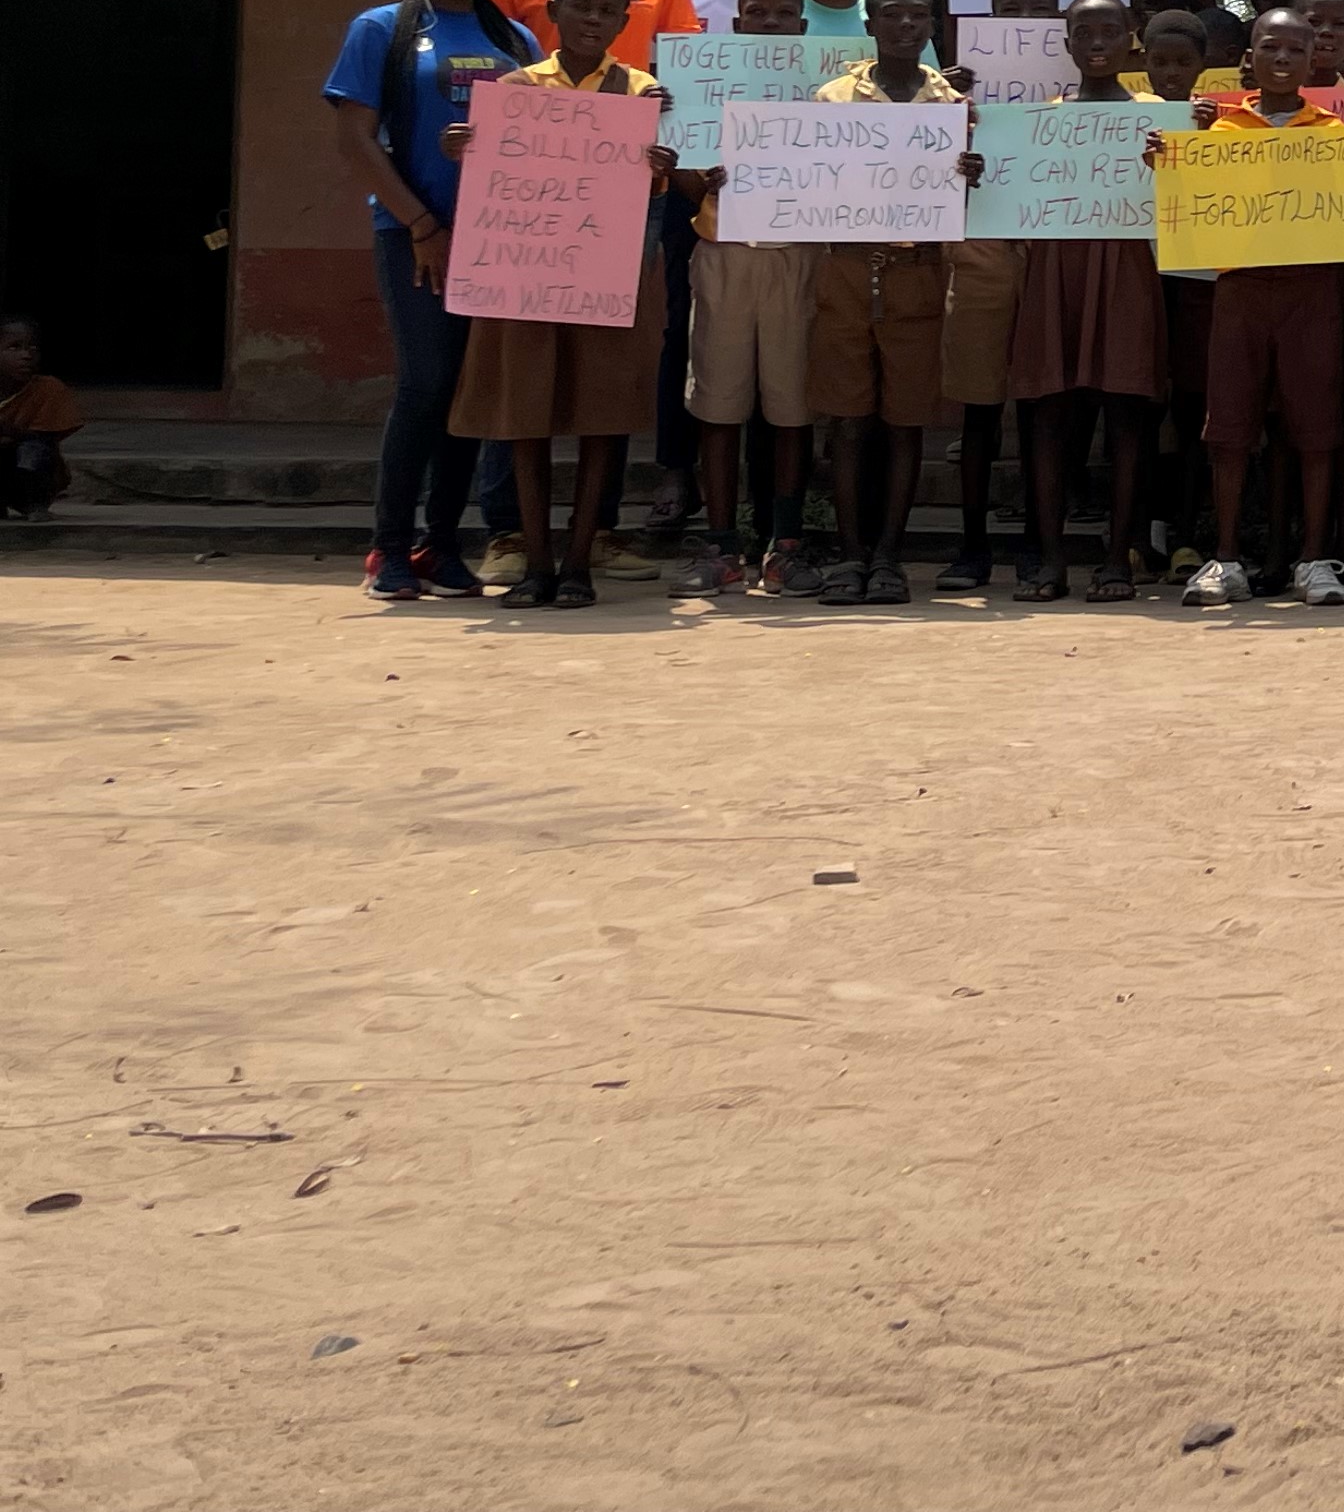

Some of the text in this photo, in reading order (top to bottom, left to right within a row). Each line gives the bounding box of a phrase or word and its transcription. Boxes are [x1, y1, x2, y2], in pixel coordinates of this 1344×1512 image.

[662, 37, 850, 75] TOGETHER WE
[968, 27, 1064, 56] LIFE
[503, 92, 600, 130] OVER
[1026, 106, 1153, 147] TOGETHER
[731, 112, 953, 152] WETLANDS ADD
[488, 170, 598, 202] PEOPLE
[733, 161, 959, 193] BEAUTY TO OUR
[1030, 157, 1077, 185] CAN
[474, 207, 603, 237] MAKE A
[770, 199, 947, 231] ENVIRONMENT
[1019, 196, 1154, 229] WETLANDS
[471, 241, 583, 274] LIVING
[519, 285, 635, 318] WETLANDS
